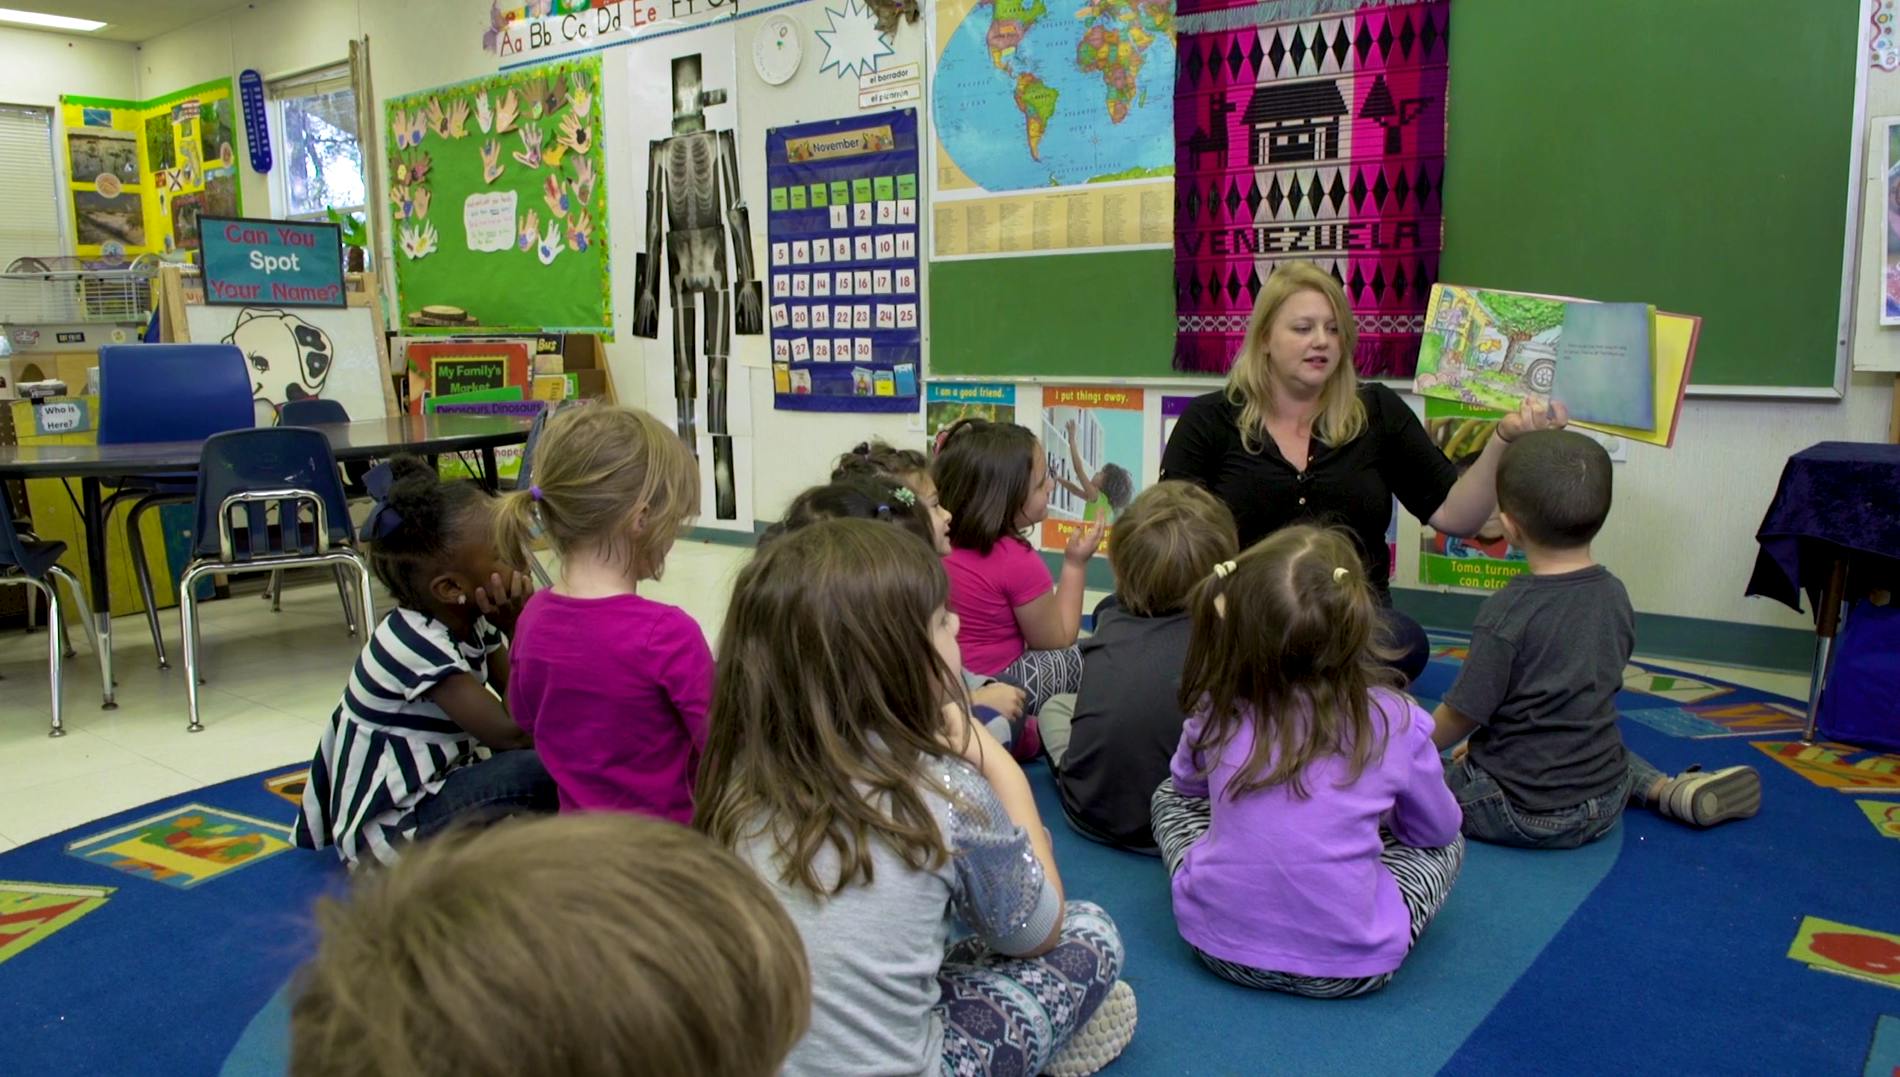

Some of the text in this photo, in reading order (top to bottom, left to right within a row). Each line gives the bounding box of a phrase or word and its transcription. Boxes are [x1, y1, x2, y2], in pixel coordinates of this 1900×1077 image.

[500, 32, 523, 56] Aa
[530, 21, 552, 49] Bb
[562, 14, 587, 41] Cc
[597, 3, 621, 35] Dd
[633, 0, 657, 27] Ee
[812, 138, 859, 152] November
[860, 209, 866, 220] 2
[883, 207, 890, 218] 3
[902, 208, 909, 217] 4
[225, 224, 316, 248] Can You
[1181, 222, 1420, 256] VENEZUELA
[778, 240, 910, 260] 5 6 7 8 9 10 11
[250, 250, 300, 274] Spot
[776, 276, 910, 291] 12 13 14 15 16 17 18
[210, 280, 260, 298] Your
[272, 282, 340, 302] Name?
[775, 310, 913, 322] 19 20 21 22 23 24 25
[538, 338, 557, 352] Bus
[776, 344, 869, 356] 26 27 28 29 30
[438, 364, 502, 380] My Family's
[940, 388, 951, 396] am
[960, 387, 977, 400] good
[980, 387, 1004, 399] friend.
[1060, 391, 1074, 403] put
[1076, 390, 1101, 404] things
[1104, 392, 1129, 404] away.
[44, 406, 75, 415] Who is
[48, 420, 73, 430] Here?
[1451, 561, 1480, 574] Tomo
[1459, 577, 1480, 588] con
